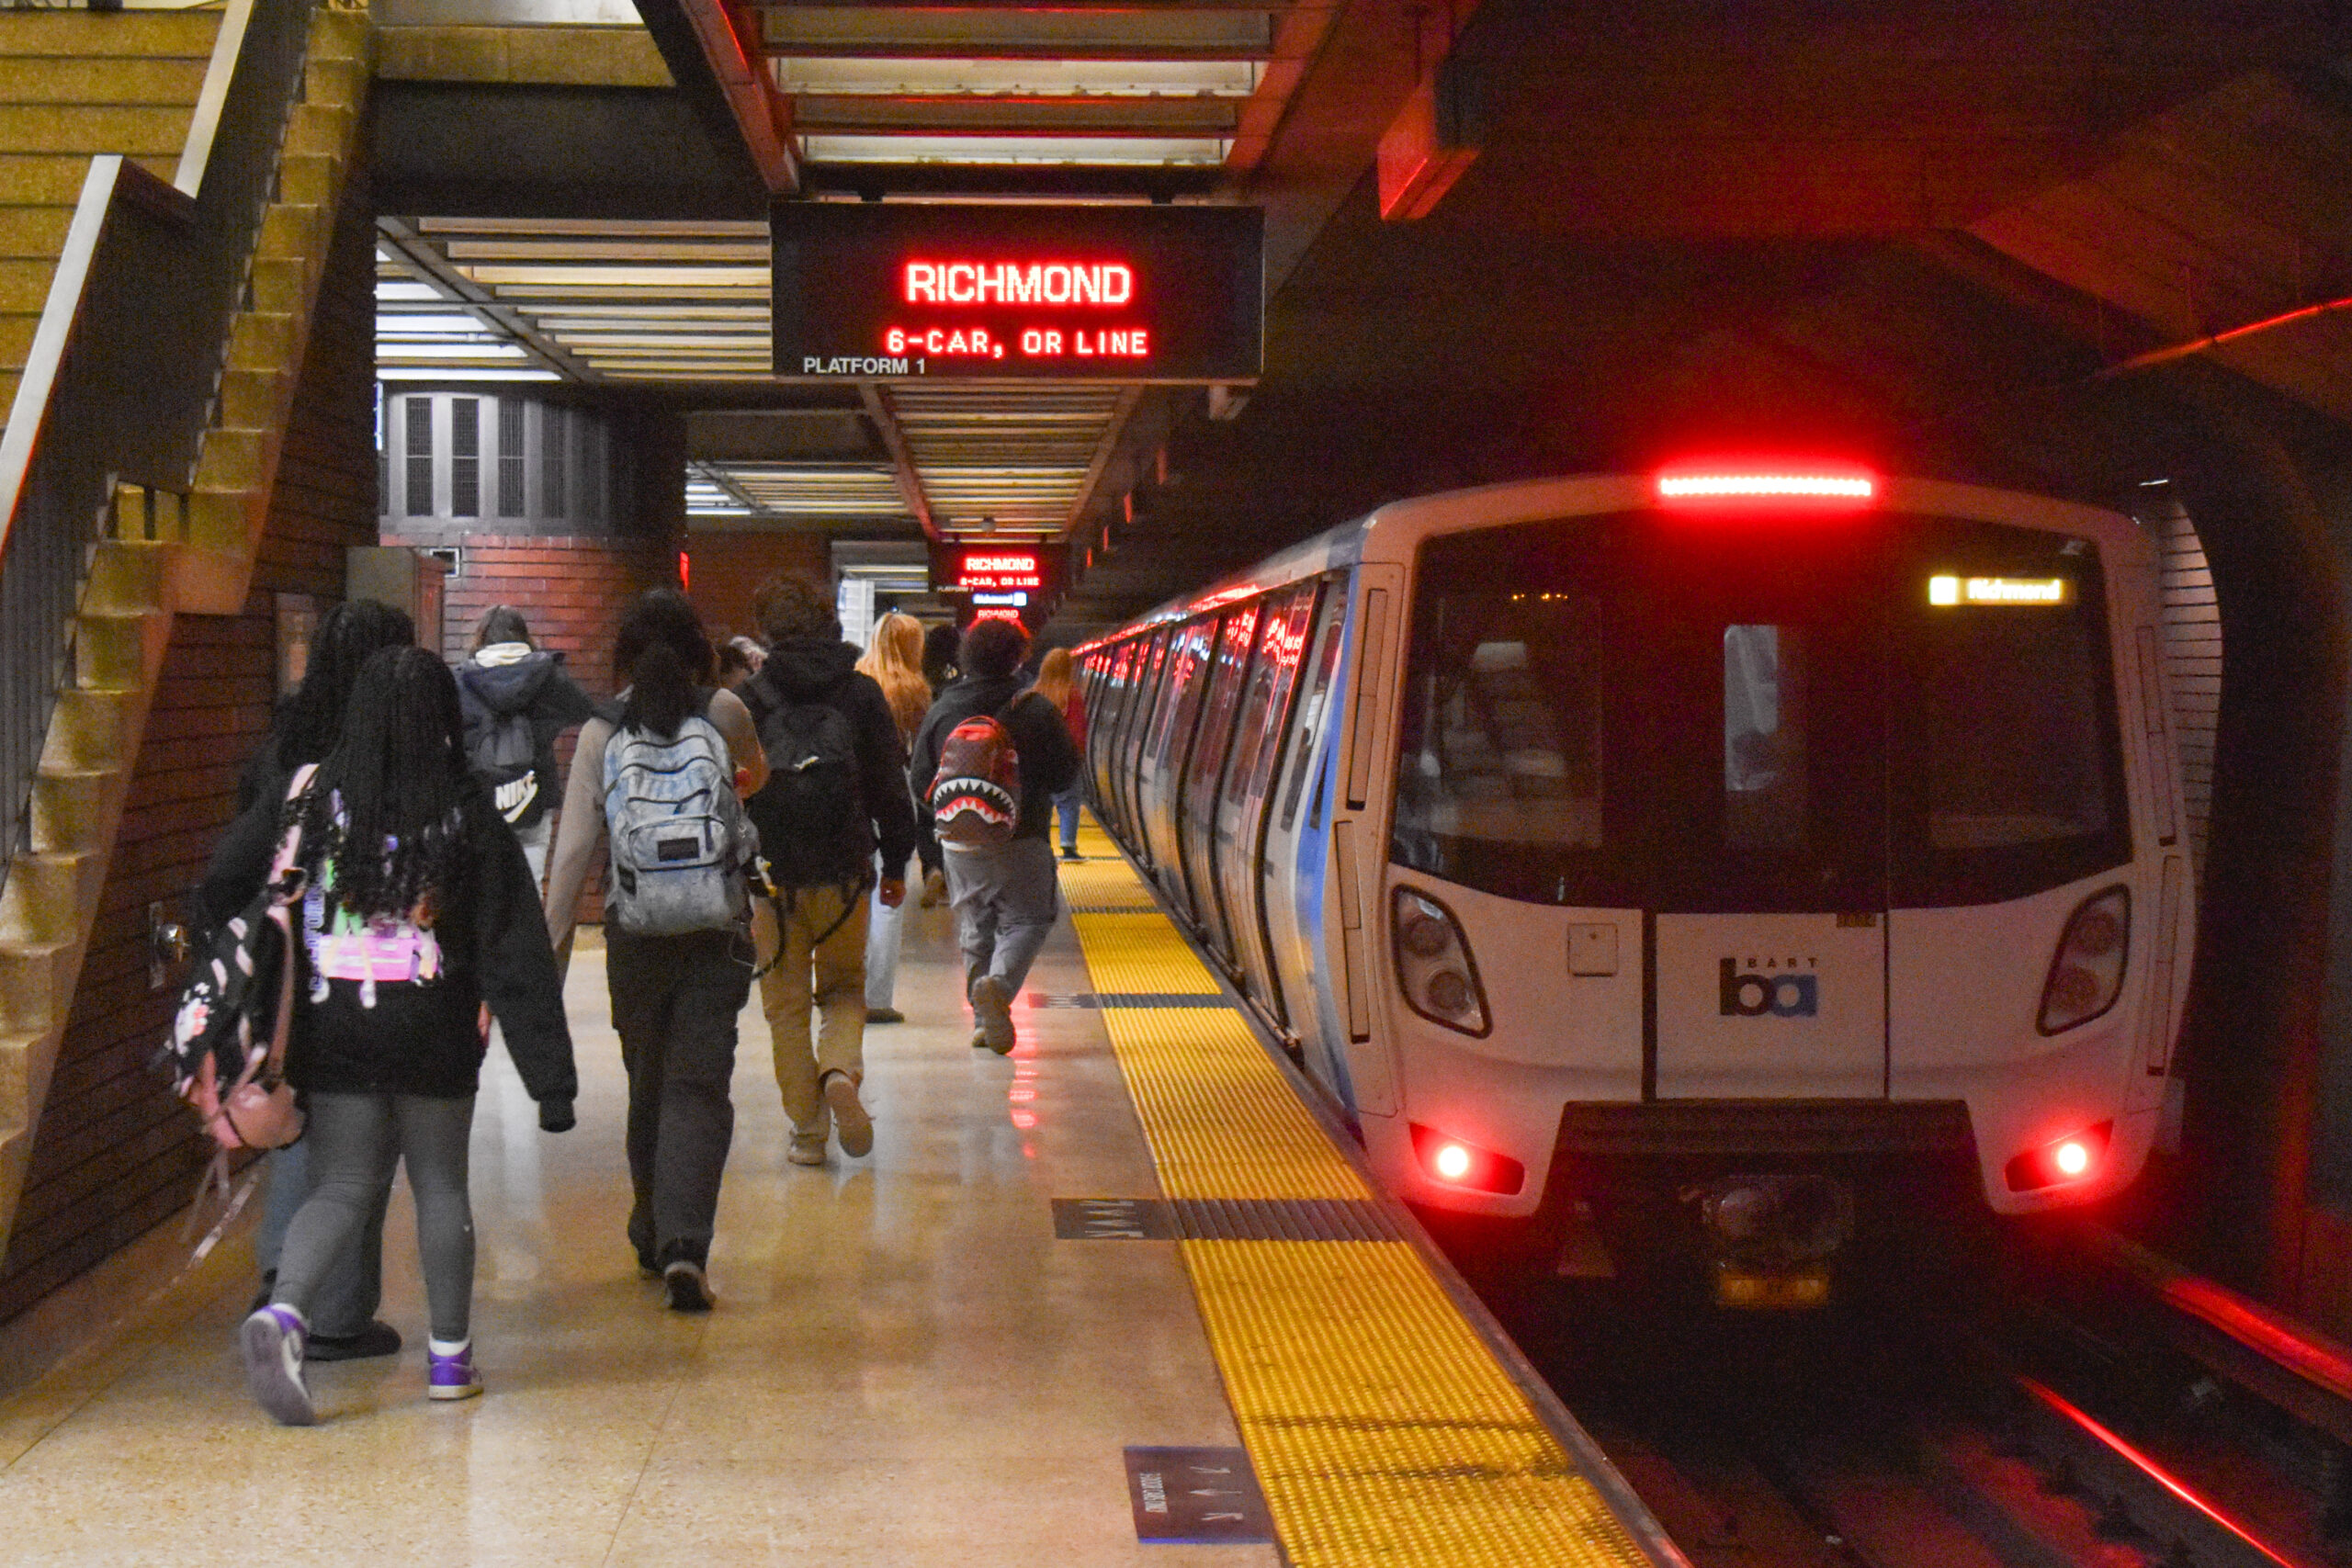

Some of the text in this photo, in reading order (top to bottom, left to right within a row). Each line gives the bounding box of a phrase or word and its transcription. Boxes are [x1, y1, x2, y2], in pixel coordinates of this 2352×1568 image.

[906, 264, 1131, 303] RICHMOND
[886, 330, 1148, 358] 6-CAR, OR LINE
[803, 357, 925, 375] PLATFORM 1
[966, 558, 1035, 570] RICHMOND
[1000, 577, 1014, 586] OR
[1016, 577, 1039, 586] LINE
[1968, 578, 2061, 601] Richmond
[495, 770, 536, 810] NIKE
[1747, 957, 1818, 968] BART
